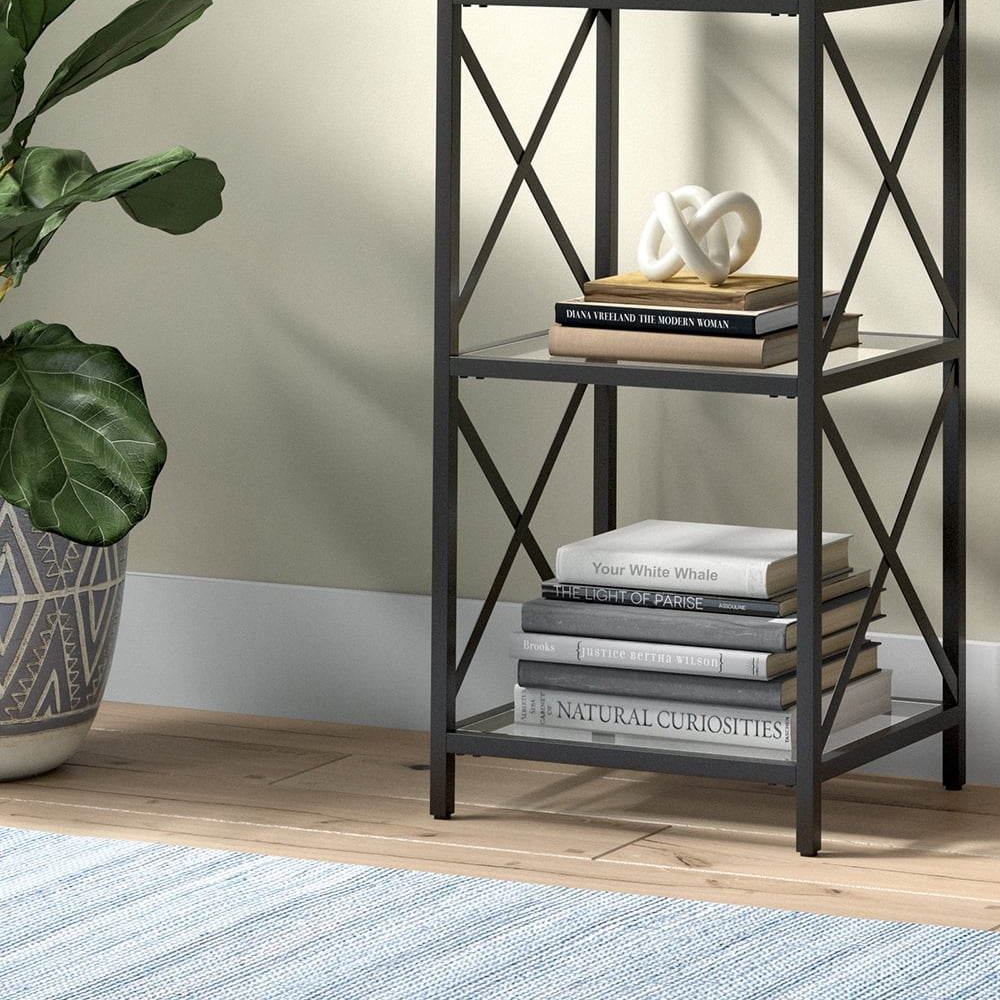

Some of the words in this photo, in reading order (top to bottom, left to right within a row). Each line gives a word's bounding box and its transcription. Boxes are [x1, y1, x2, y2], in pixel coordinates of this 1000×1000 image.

[566, 309, 591, 320] DIANA
[593, 311, 636, 323] VREELAND
[638, 313, 656, 324] THE
[658, 315, 695, 327] MODERN
[697, 318, 729, 329] WOMAN
[592, 562, 625, 576] Your
[629, 564, 670, 578] White
[674, 567, 718, 581] Whale
[553, 584, 580, 599] THE
[585, 587, 628, 603] LIGHT
[631, 591, 650, 605] OF
[654, 593, 703, 610] PARISE
[523, 639, 555, 652] Brooks
[557, 700, 652, 727] NATURAL
[657, 710, 782, 739] CURIOSITIES
